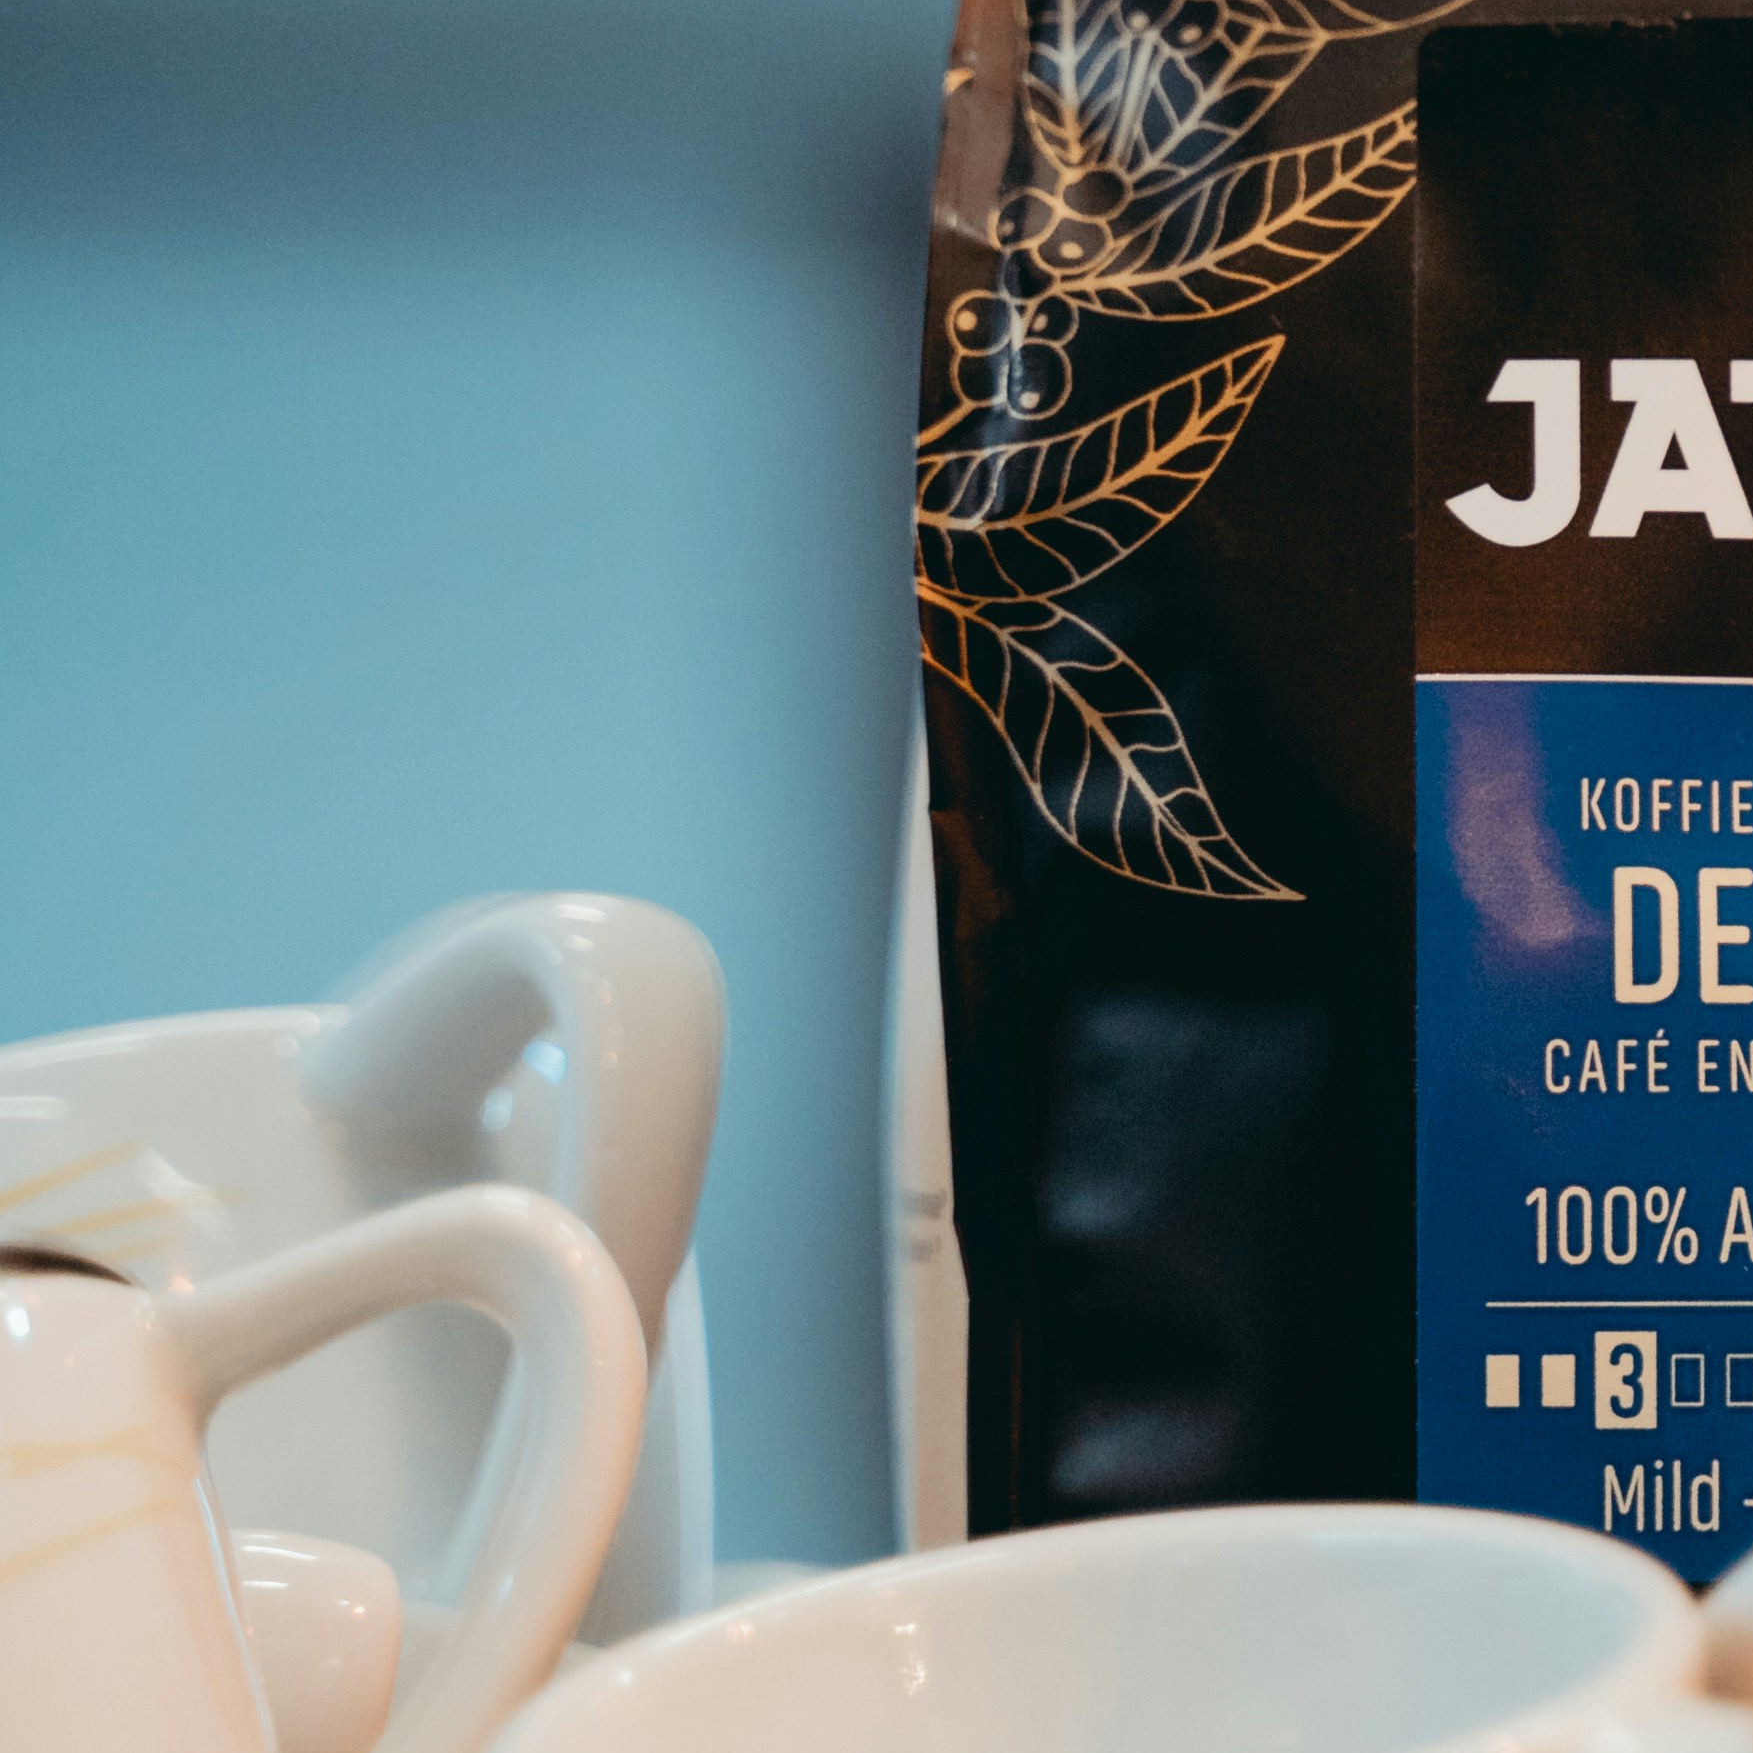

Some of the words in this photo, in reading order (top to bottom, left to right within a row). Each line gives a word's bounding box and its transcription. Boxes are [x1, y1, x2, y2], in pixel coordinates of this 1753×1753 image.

[1544, 1028, 1671, 1094] CAFÉ
[1525, 1185, 1699, 1265] 100%
[1609, 1343, 1644, 1419] 3
[1603, 1459, 1720, 1532] Mild
